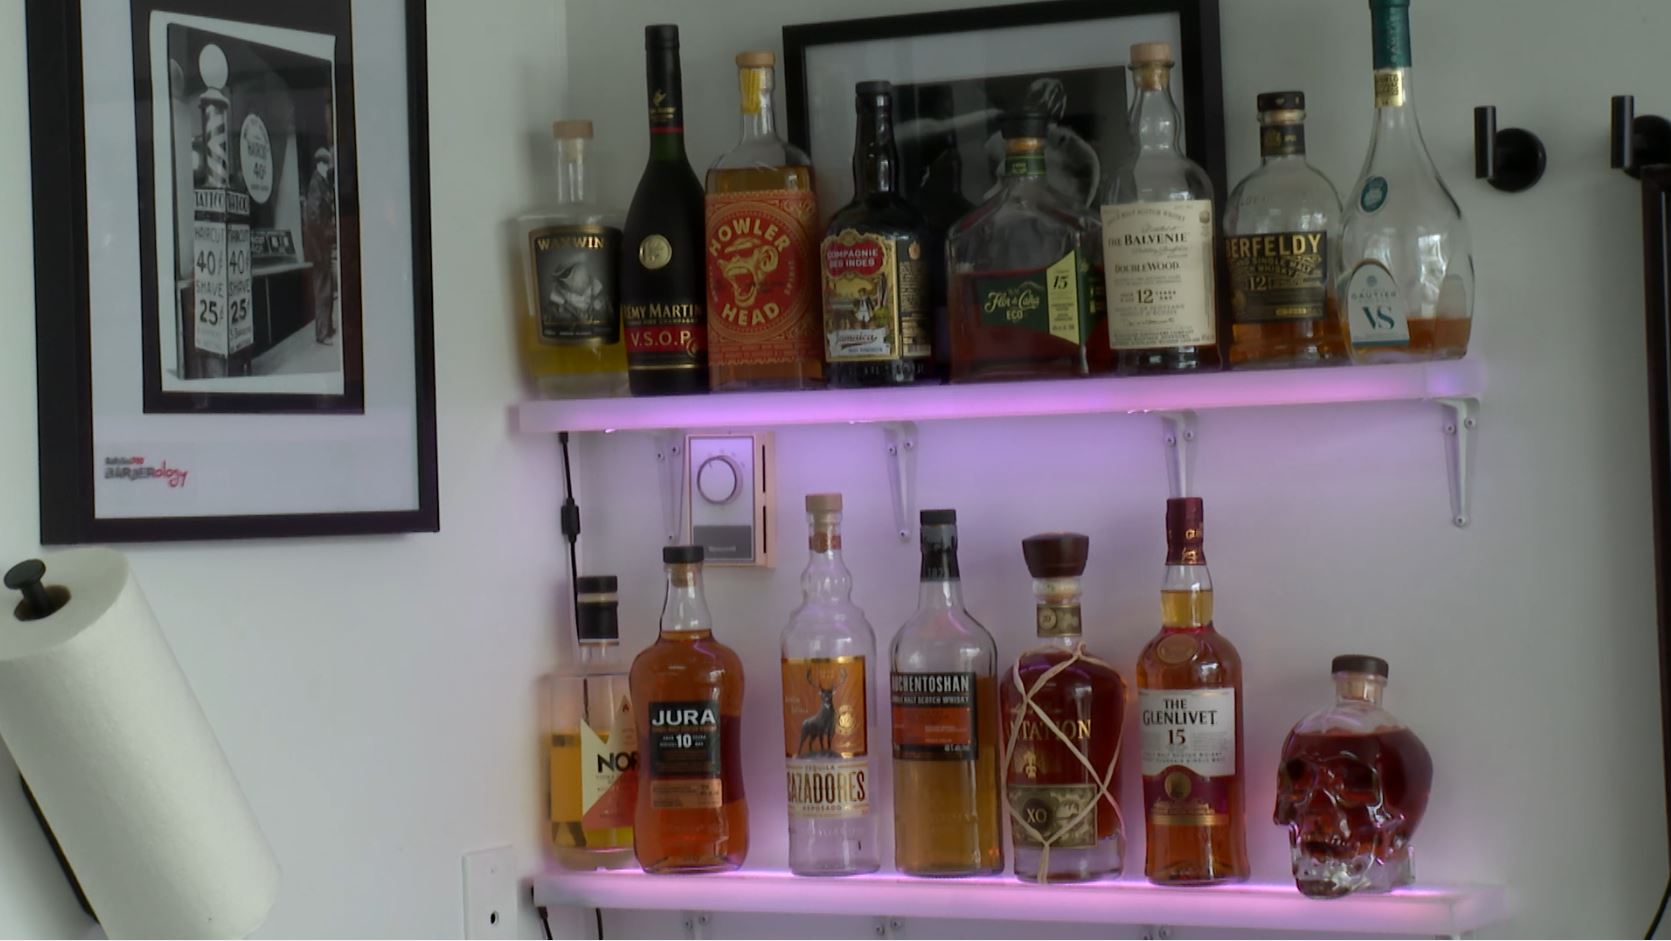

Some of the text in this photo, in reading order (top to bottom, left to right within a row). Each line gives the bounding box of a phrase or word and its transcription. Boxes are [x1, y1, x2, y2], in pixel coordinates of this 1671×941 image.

[709, 217, 791, 257] HOWLER
[1124, 233, 1186, 246] BALVENIE
[826, 248, 879, 259] COMPAGNIE
[196, 280, 224, 298] SHAVE
[1053, 275, 1069, 290] 15
[1249, 275, 1267, 291] 12
[1137, 289, 1154, 304] 12
[721, 302, 781, 326] HEAD
[1362, 305, 1395, 330] VS
[1163, 698, 1188, 709] THE
[652, 708, 717, 727] JURA
[1143, 710, 1217, 726] GLENLIVET
[676, 733, 693, 749] 10
[1168, 729, 1187, 746] 15
[1027, 808, 1047, 823] XO
